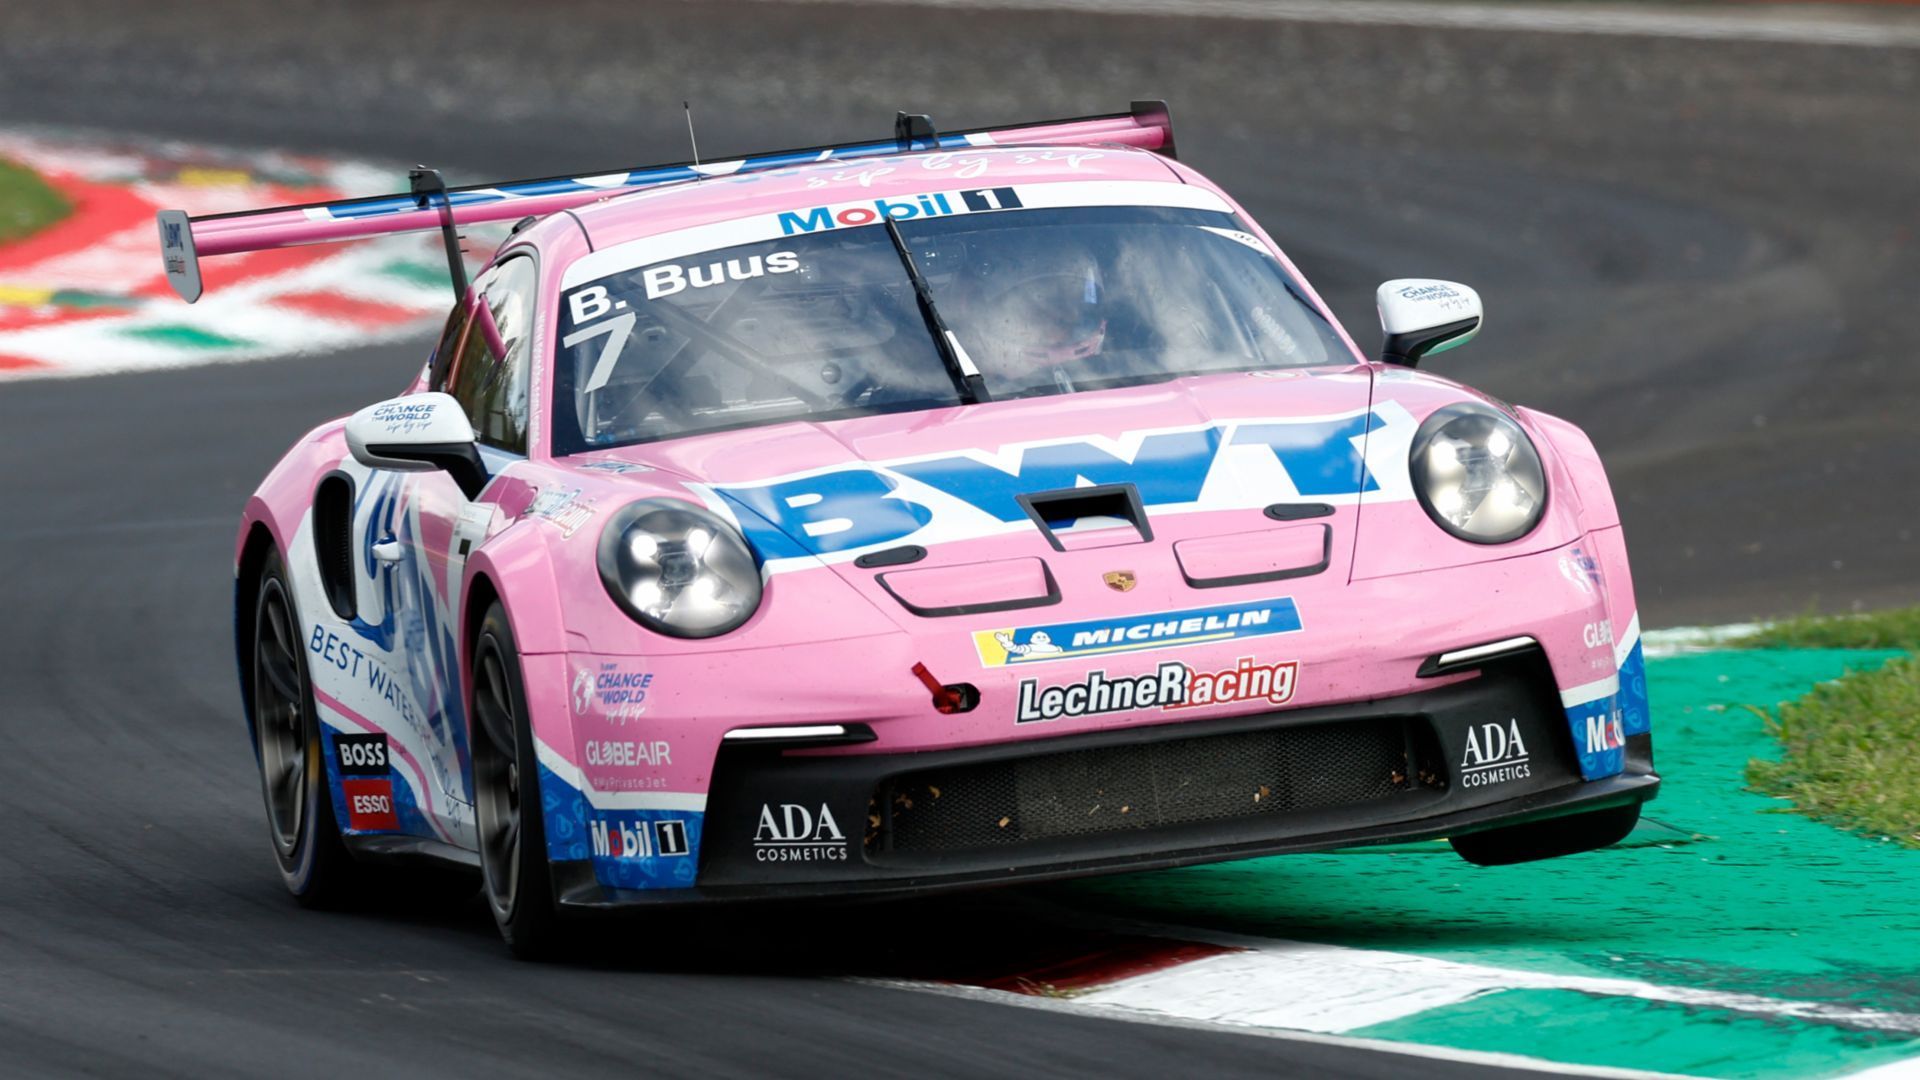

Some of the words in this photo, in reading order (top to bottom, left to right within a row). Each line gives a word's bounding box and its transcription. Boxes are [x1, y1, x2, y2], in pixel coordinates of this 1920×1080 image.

[778, 193, 952, 235] Mobil
[975, 189, 1003, 210] 1
[569, 285, 627, 326] B.
[643, 251, 800, 301] Buus
[563, 312, 637, 394] 7
[374, 405, 437, 416] CHANGE
[385, 413, 431, 421] WORLD
[713, 411, 1388, 560] BWT
[1072, 609, 1271, 647] MICHELIN
[310, 624, 364, 678] BEST
[597, 673, 653, 689] CHANGE
[603, 690, 645, 704] WORLD
[339, 742, 385, 766] BOSS
[586, 740, 672, 766] GLOBEAIR
[1461, 718, 1528, 767] ADA
[1463, 764, 1531, 788] COSMETICS
[353, 795, 389, 814] ESSO
[753, 802, 846, 841] ADA
[591, 820, 652, 858] Mobil
[756, 847, 848, 862] COSMETICS
